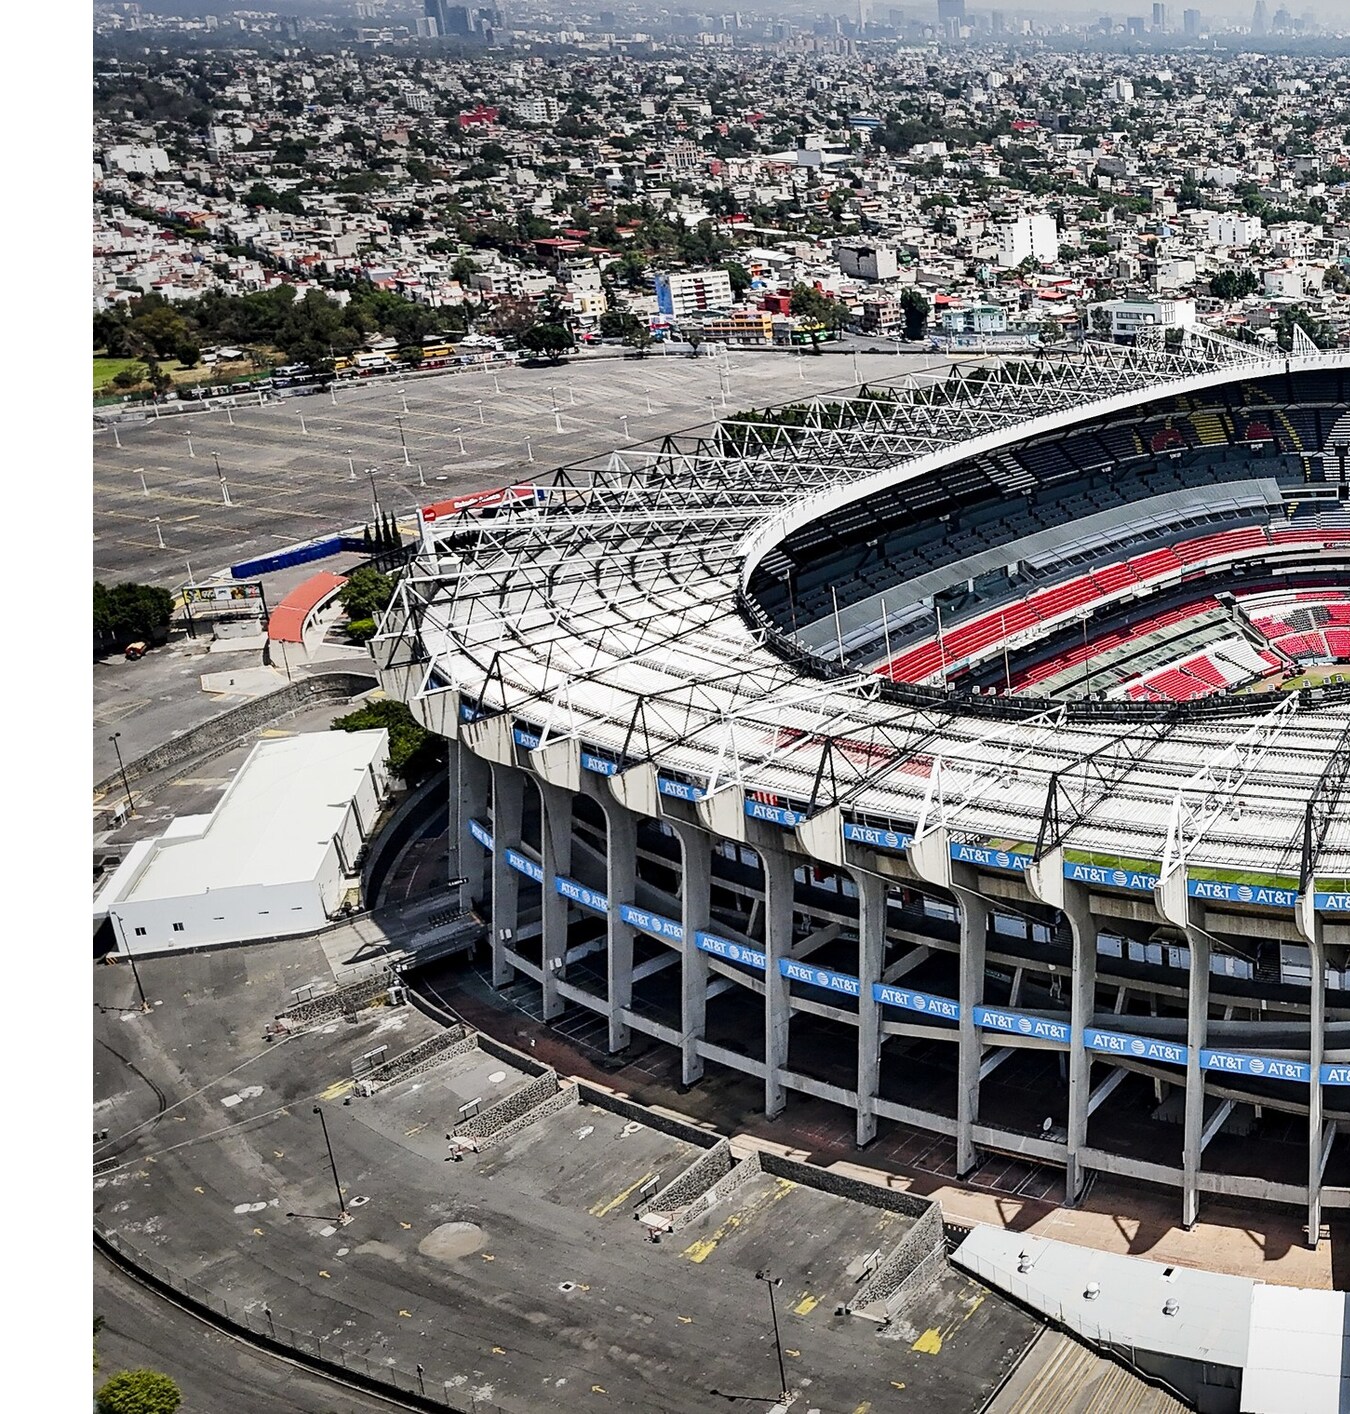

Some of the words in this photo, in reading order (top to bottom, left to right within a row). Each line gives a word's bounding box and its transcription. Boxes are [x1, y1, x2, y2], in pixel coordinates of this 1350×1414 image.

[588, 758, 609, 775] AT&T
[665, 782, 689, 798] AT&T
[754, 806, 780, 822] AT&T
[852, 827, 881, 843] AT&T
[960, 848, 992, 862] AT&T
[534, 867, 543, 879] AT
[1074, 866, 1107, 881] AT&T
[1131, 876, 1158, 888] AT&
[562, 883, 580, 898] AT&T
[592, 897, 608, 910] AT&
[1195, 883, 1232, 898] AT&T
[1257, 890, 1294, 904] AT&T
[628, 911, 649, 926] AT&T
[703, 938, 726, 953] AT&T
[787, 965, 813, 980] AT&T
[832, 977, 858, 992] AT&T
[881, 990, 909, 1005] AT&T
[929, 1002, 958, 1016] AT&T
[983, 1014, 1013, 1028] AT&T
[1035, 1023, 1066, 1038] AT&T
[1094, 1035, 1126, 1050] AT&T
[1149, 1045, 1182, 1060] AT&T
[1209, 1055, 1244, 1070] AT&T
[1268, 1063, 1304, 1078] AT&T
